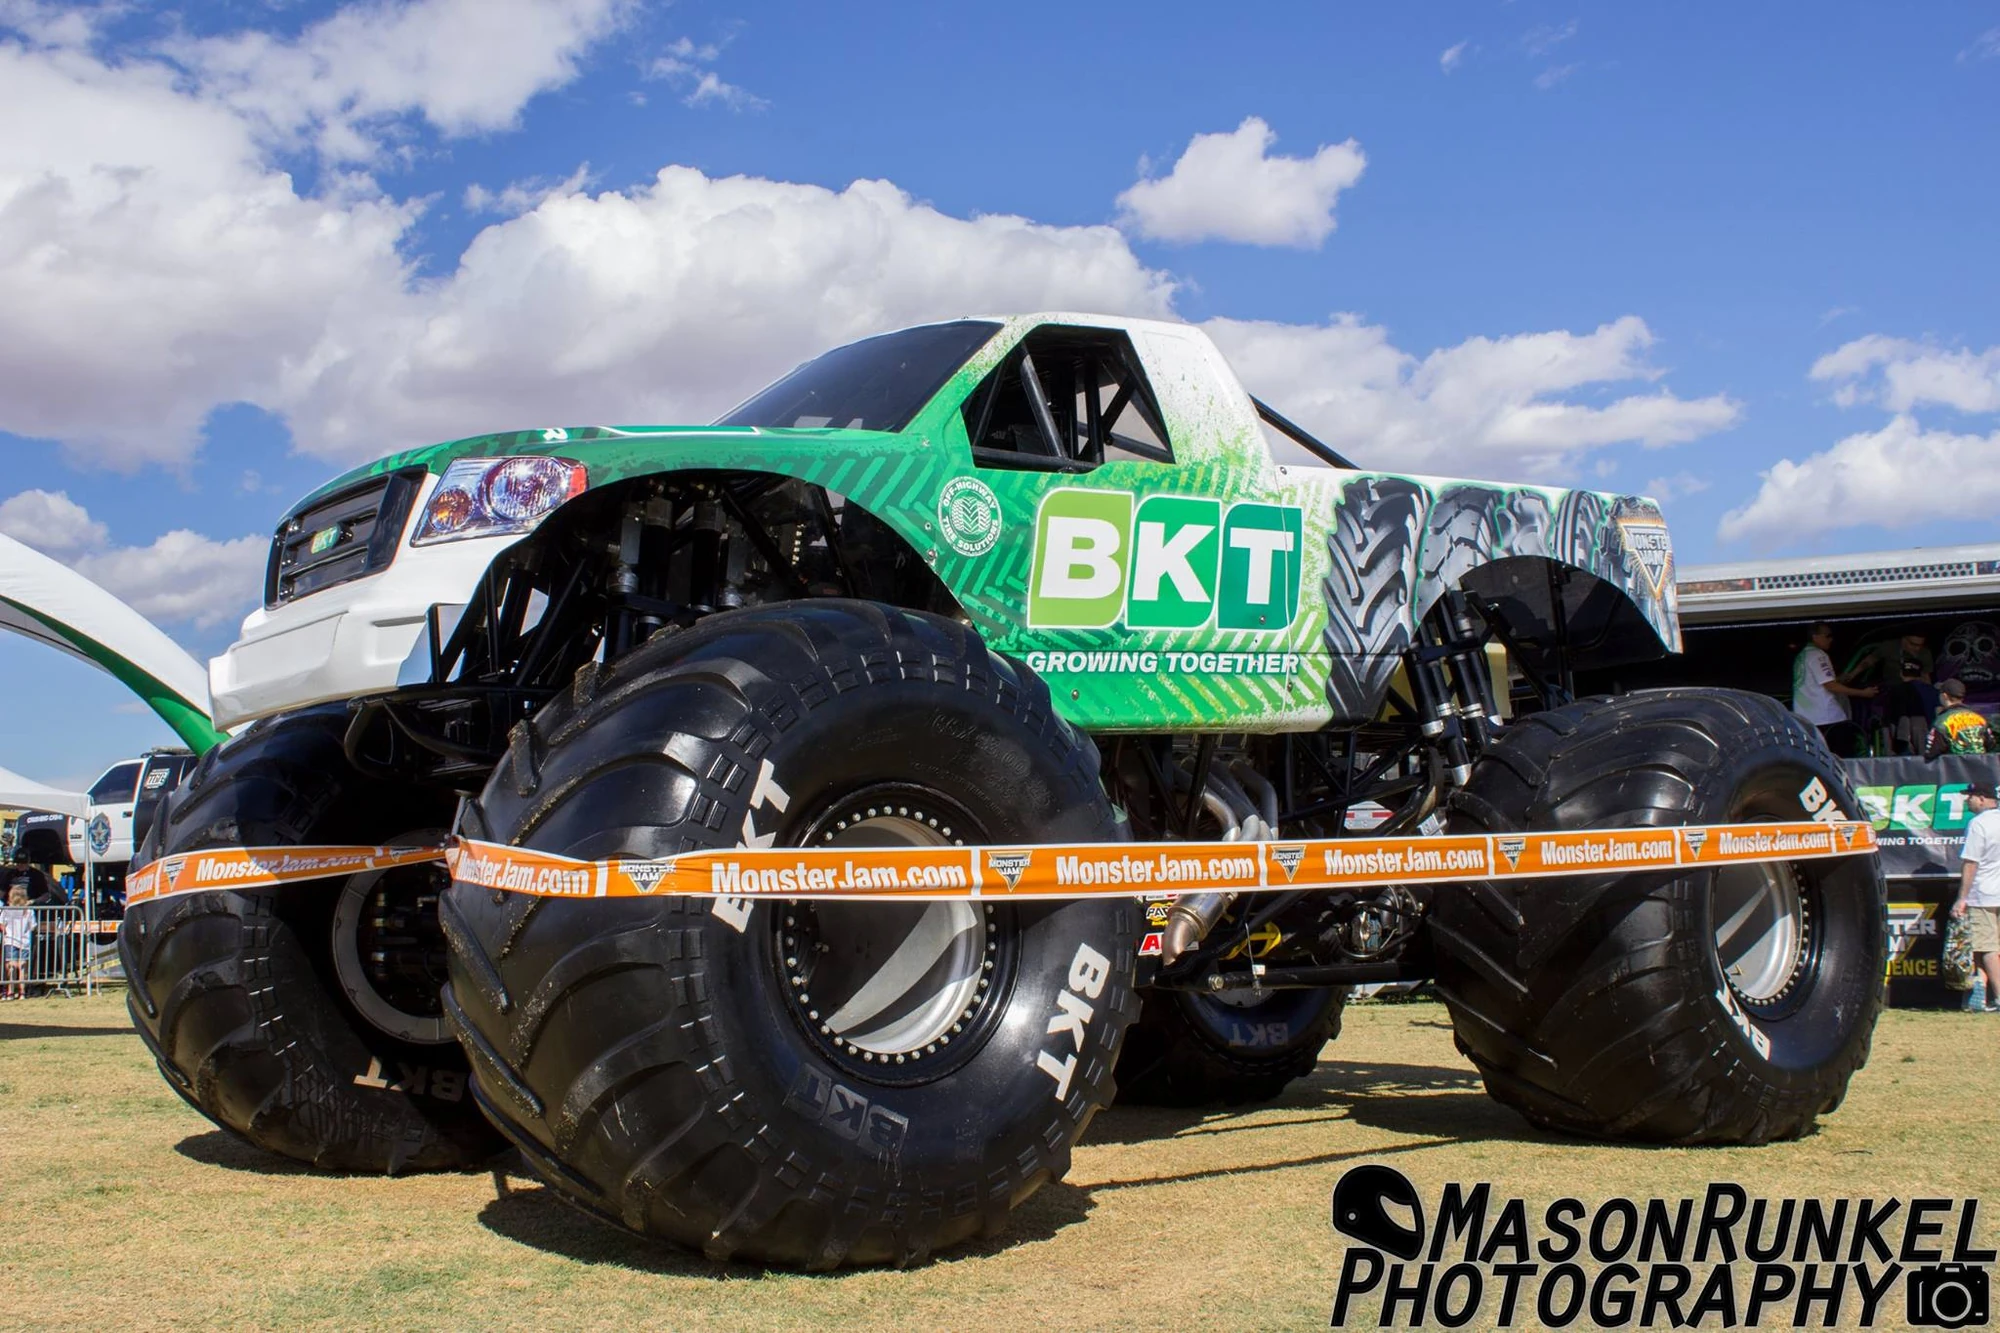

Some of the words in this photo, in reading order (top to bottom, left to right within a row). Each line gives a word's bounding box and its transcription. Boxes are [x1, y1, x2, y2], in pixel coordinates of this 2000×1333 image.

[943, 481, 997, 508] OFF-HIGHWAY
[942, 516, 958, 541] TIRE
[957, 520, 998, 551] SOLUTIONS
[1038, 515, 1295, 605] BKT
[1028, 650, 1159, 674] GROWING
[1166, 652, 1300, 675] TOGETHER
[1541, 838, 1673, 865] MonsterJam.com
[1719, 830, 1829, 855] MonsterJam.com
[1908, 836, 1968, 845] TOGETHE
[618, 862, 678, 875] MONSTER
[987, 857, 1032, 868] MONSTER
[1000, 867, 1021, 876] JAM
[1056, 854, 1255, 885] MonsterJam.com
[1324, 846, 1485, 876] MonsterJam.com
[633, 872, 661, 882] JAM
[711, 861, 968, 893] MonsterJam.com
[1036, 941, 1112, 1102] BKT
